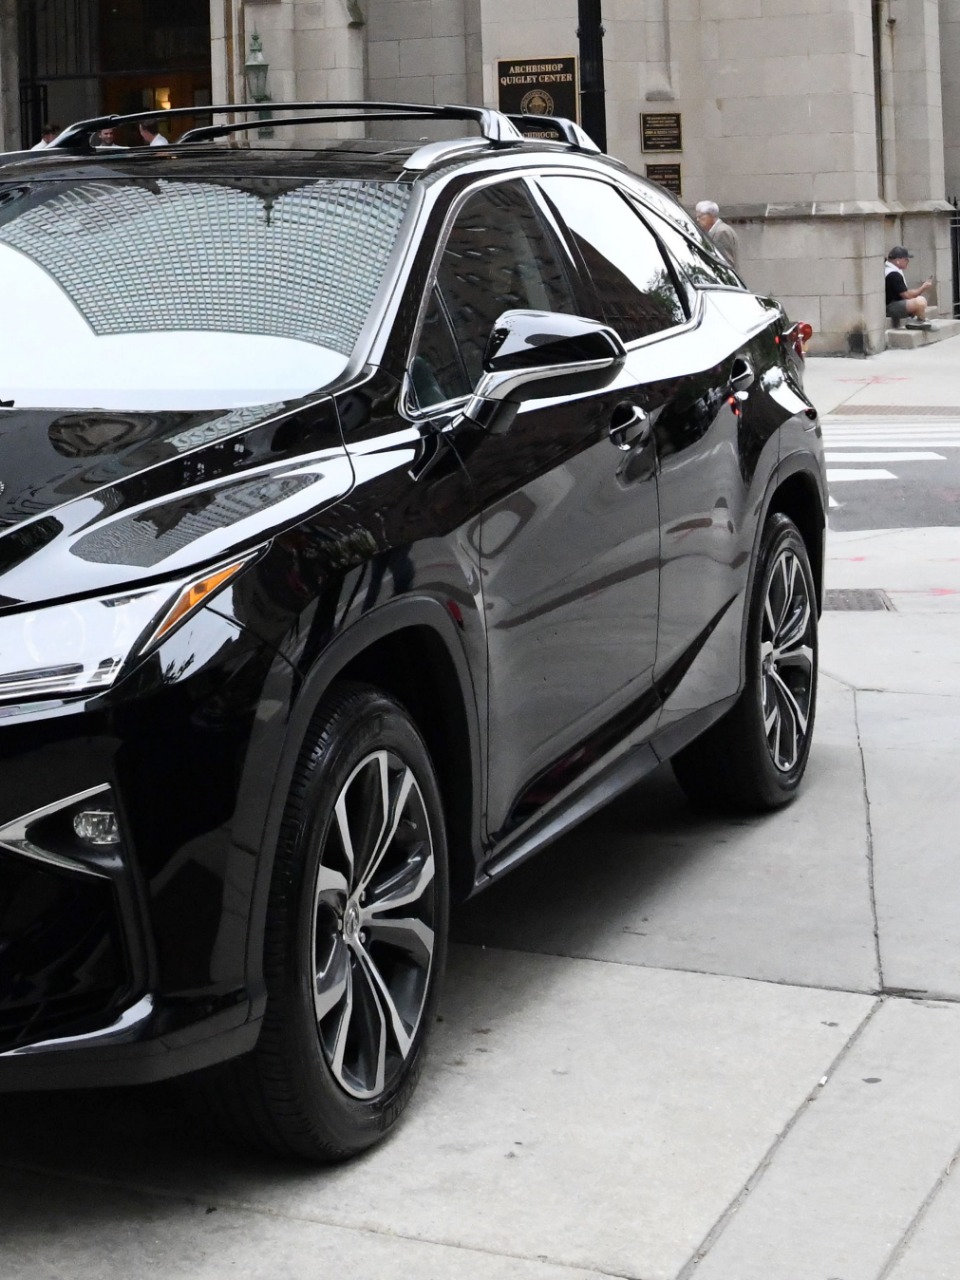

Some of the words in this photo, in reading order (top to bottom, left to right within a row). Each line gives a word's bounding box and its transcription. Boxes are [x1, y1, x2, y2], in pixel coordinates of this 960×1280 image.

[509, 64, 563, 74] ARCHBISHOP
[500, 75, 538, 86] QUIGLEY
[538, 73, 573, 83] CENTER
